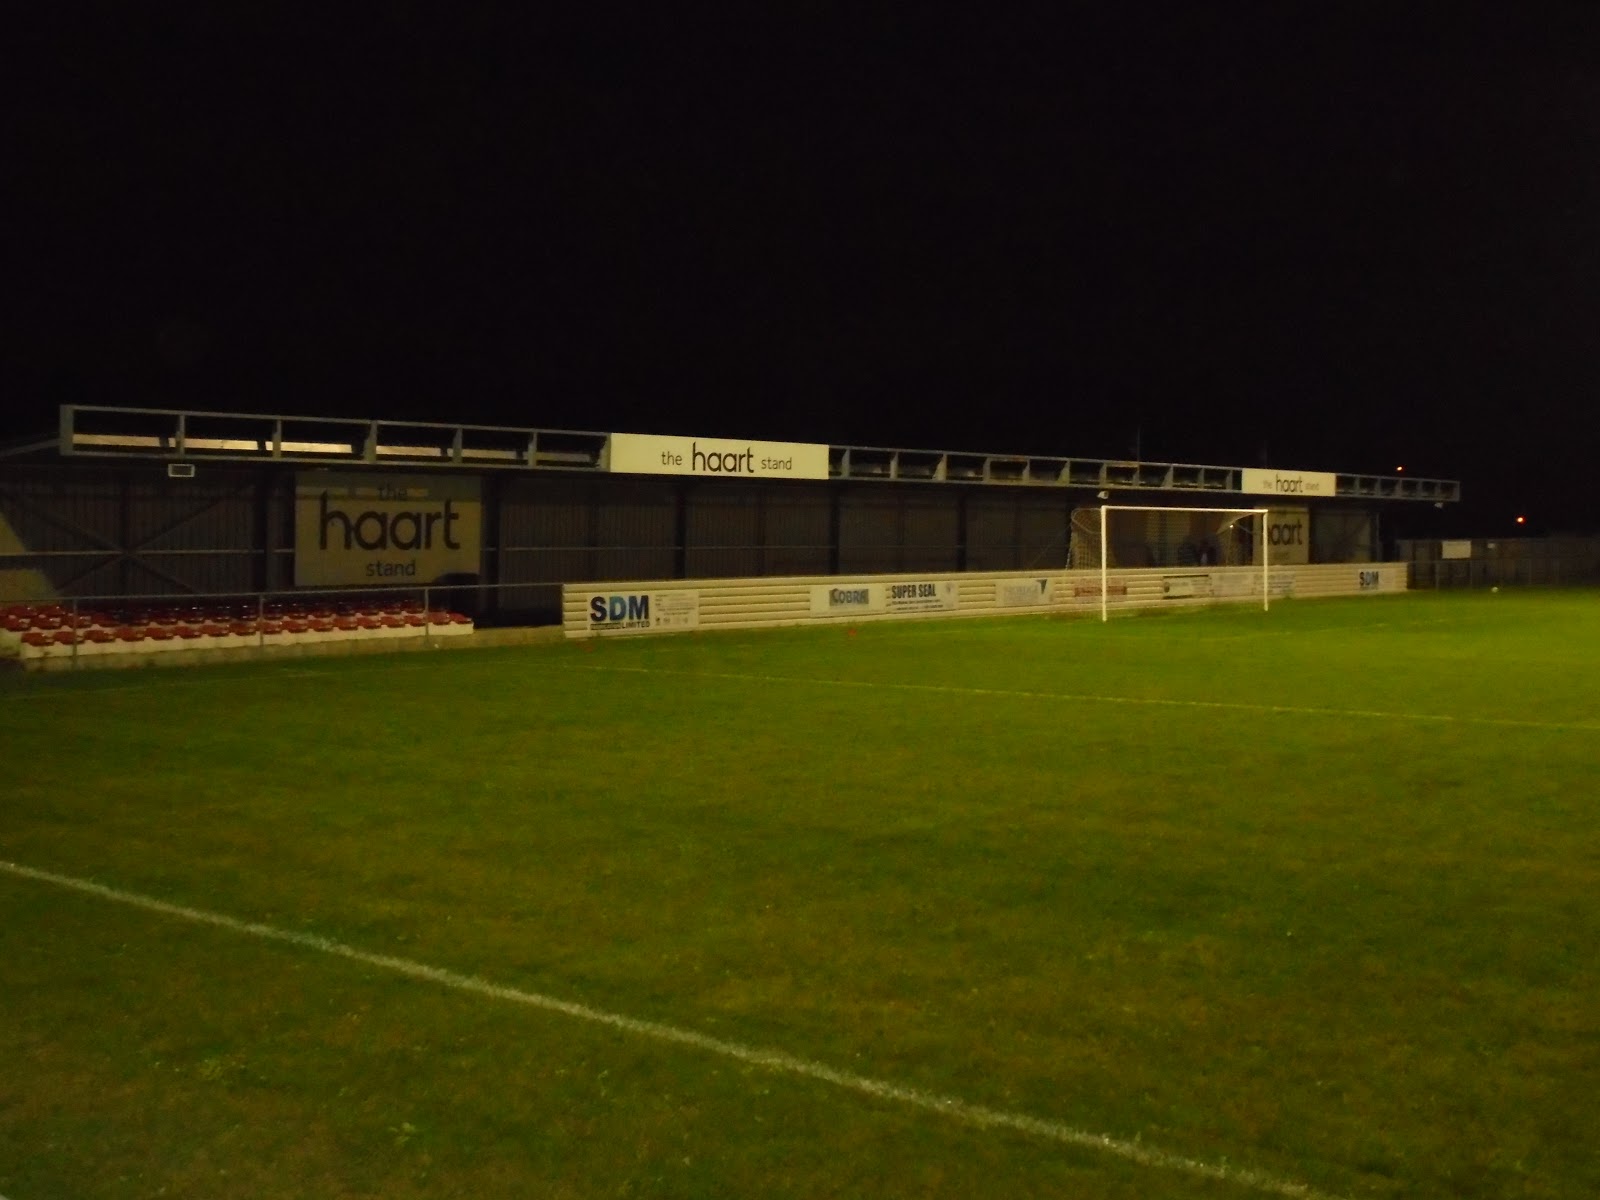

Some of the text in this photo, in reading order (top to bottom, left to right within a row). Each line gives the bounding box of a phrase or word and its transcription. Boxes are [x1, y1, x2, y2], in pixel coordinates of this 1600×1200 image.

[661, 442, 793, 473] the haart stand
[378, 484, 408, 501] the
[1275, 473, 1303, 493] haart
[320, 490, 460, 550] haart
[365, 559, 416, 577] stand
[892, 583, 937, 597] SUPER SEAL
[590, 595, 649, 622] SDM
